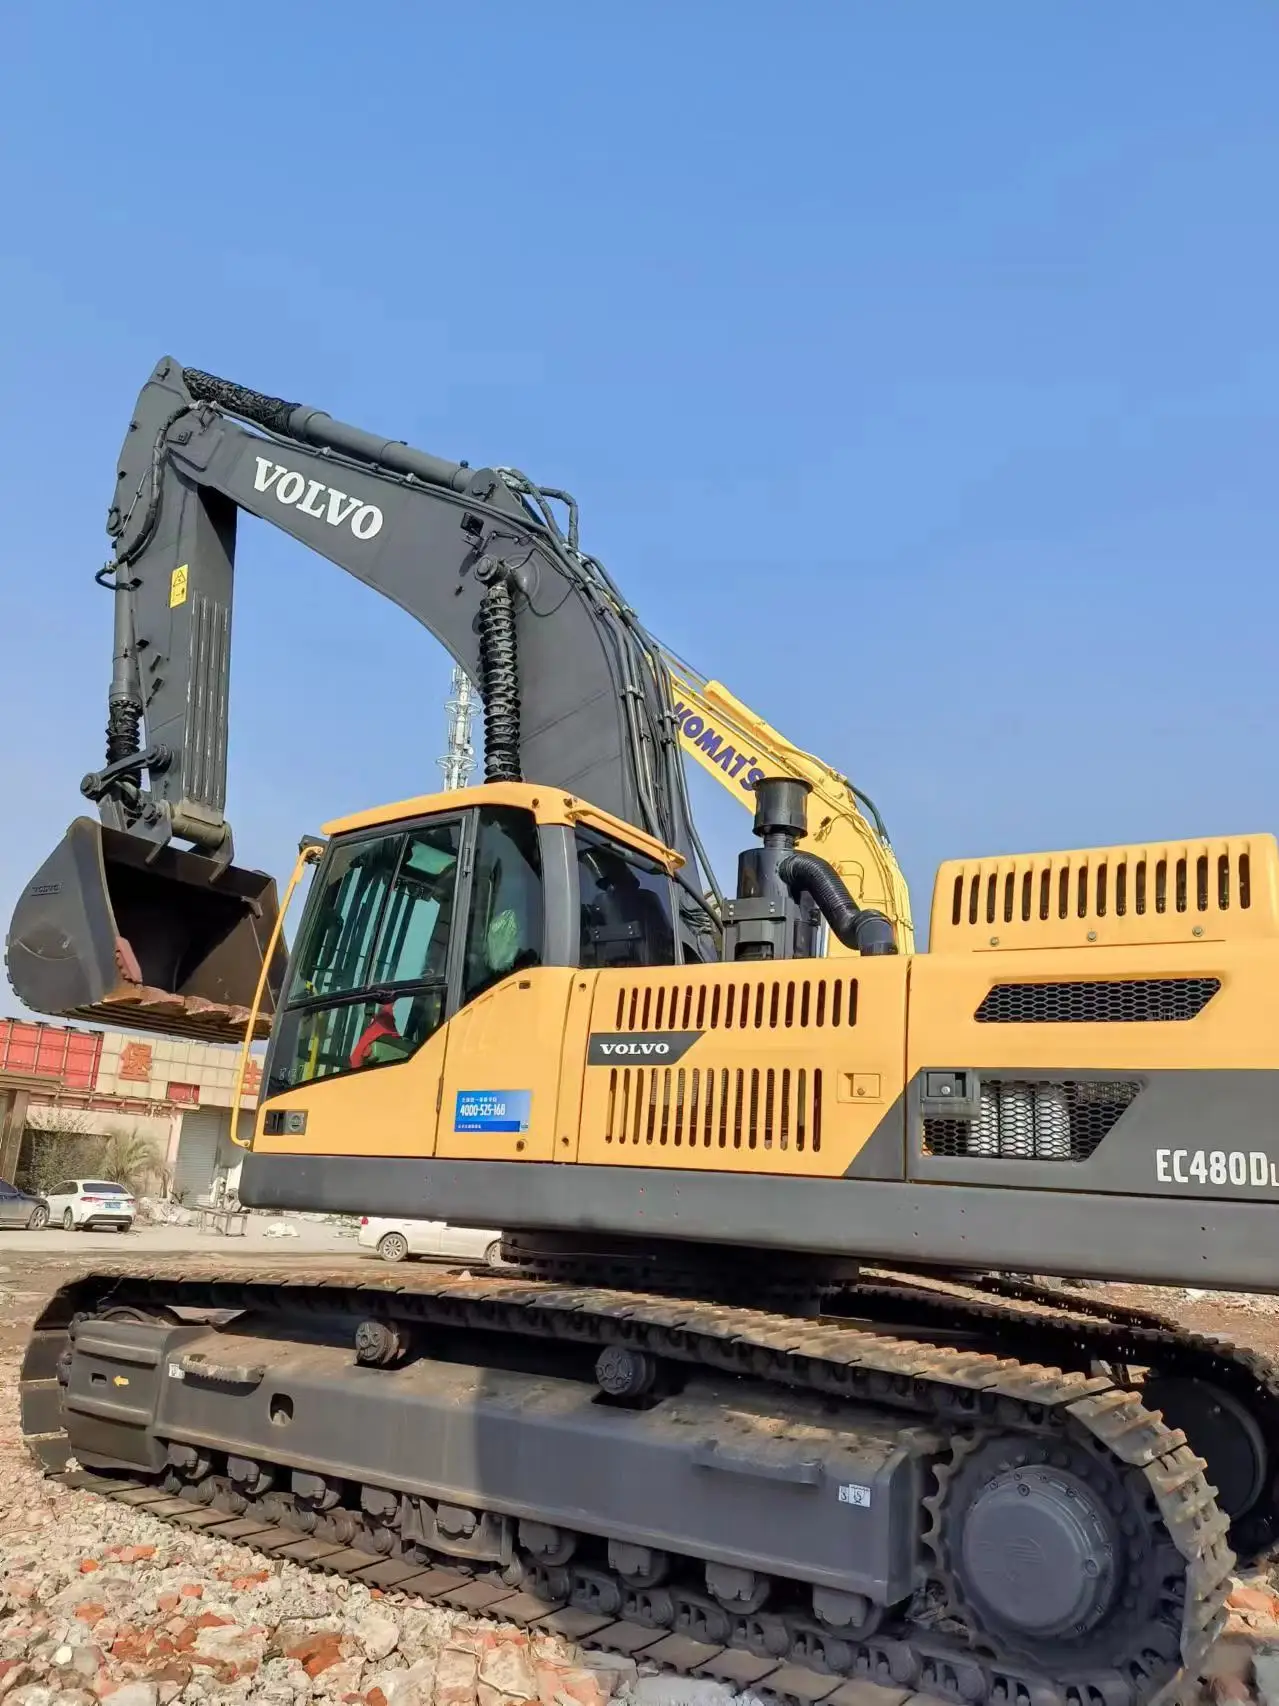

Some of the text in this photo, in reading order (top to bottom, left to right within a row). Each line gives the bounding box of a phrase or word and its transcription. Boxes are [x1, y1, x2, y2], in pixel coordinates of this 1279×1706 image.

[253, 456, 384, 540] VOLVO
[673, 701, 766, 792] KOMATS
[600, 1043, 670, 1055] VOLVO
[460, 1103, 506, 1117] 4000-525-168
